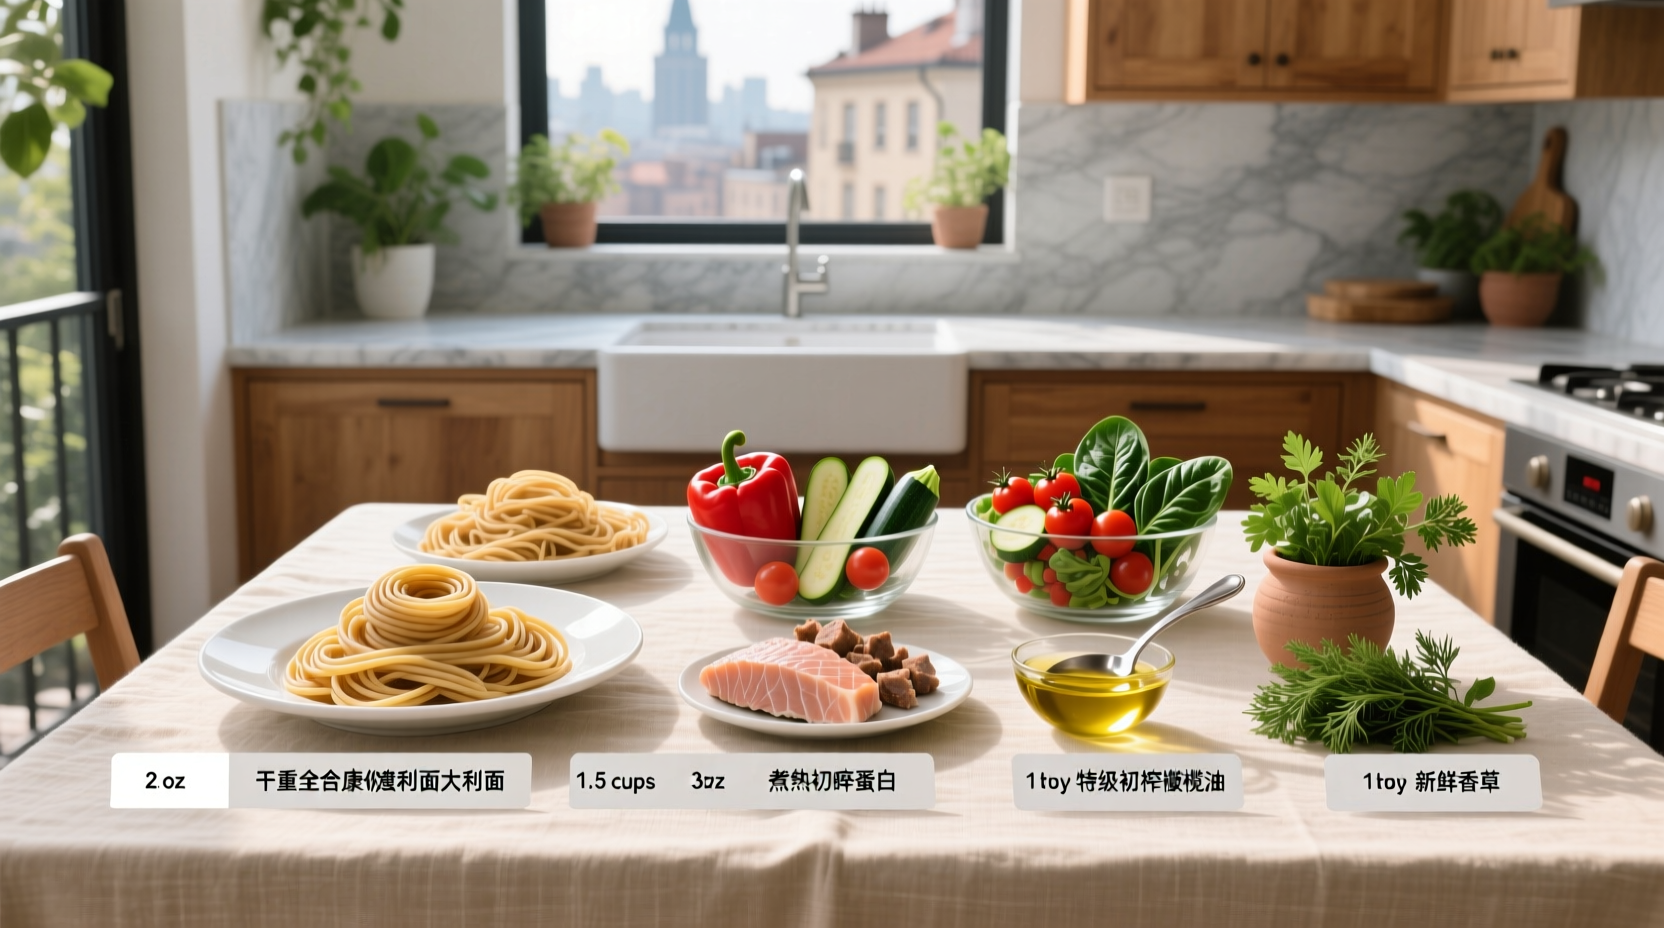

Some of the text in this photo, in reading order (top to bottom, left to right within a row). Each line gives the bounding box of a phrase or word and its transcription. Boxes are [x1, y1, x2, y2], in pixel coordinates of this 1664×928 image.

[162, 775, 186, 790] oz
[576, 771, 656, 795] 1.5 cups
[1415, 769, 1500, 793] 新鲜香草
